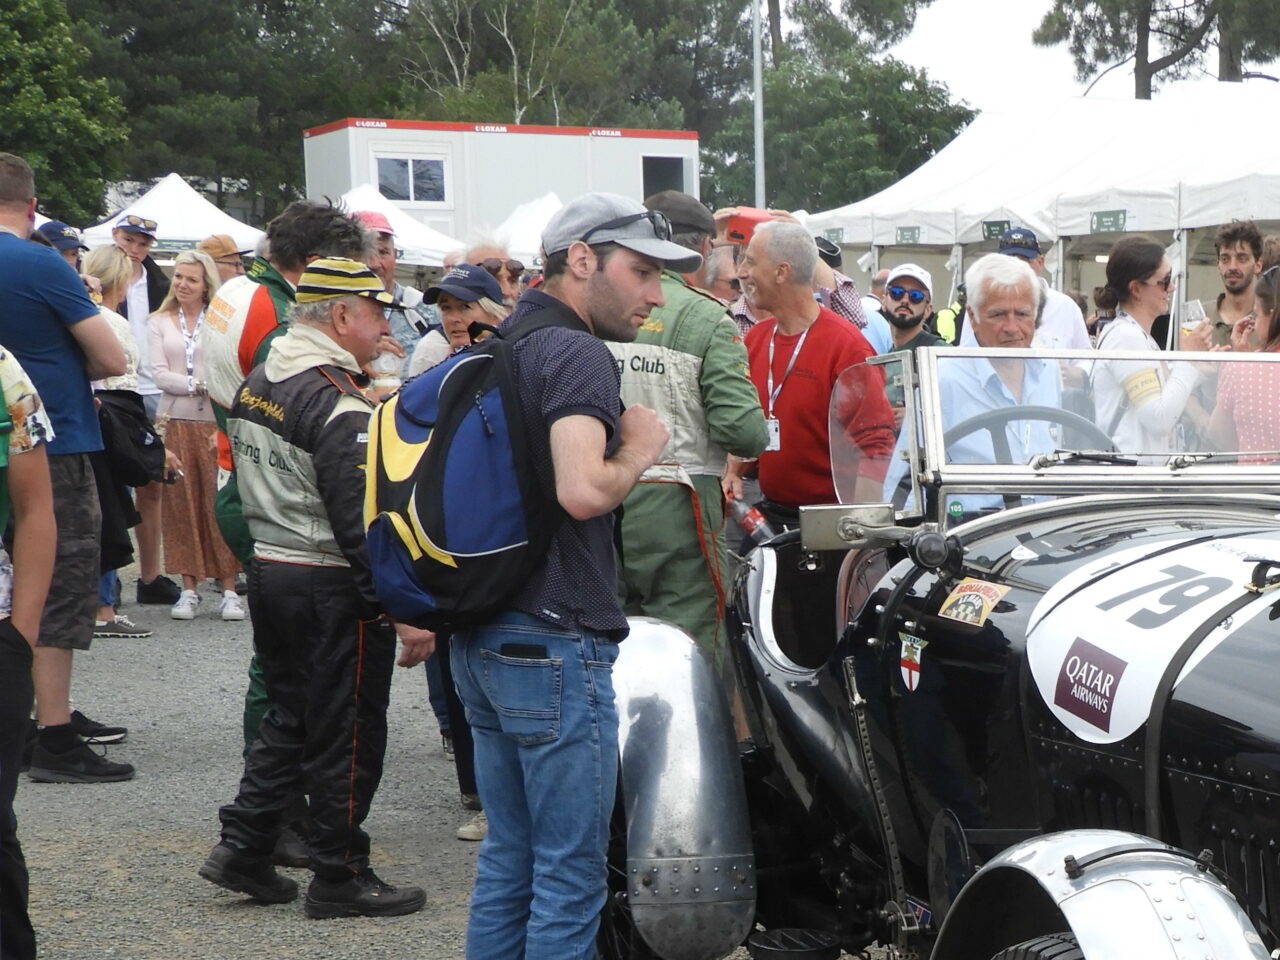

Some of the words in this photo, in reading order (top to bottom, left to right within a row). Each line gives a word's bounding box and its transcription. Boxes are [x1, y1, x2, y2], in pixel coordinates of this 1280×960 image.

[630, 355, 665, 375] Club
[1095, 564, 1234, 630] 79
[1066, 656, 1114, 698] QATAR
[1071, 685, 1109, 714] AIRWAYS
